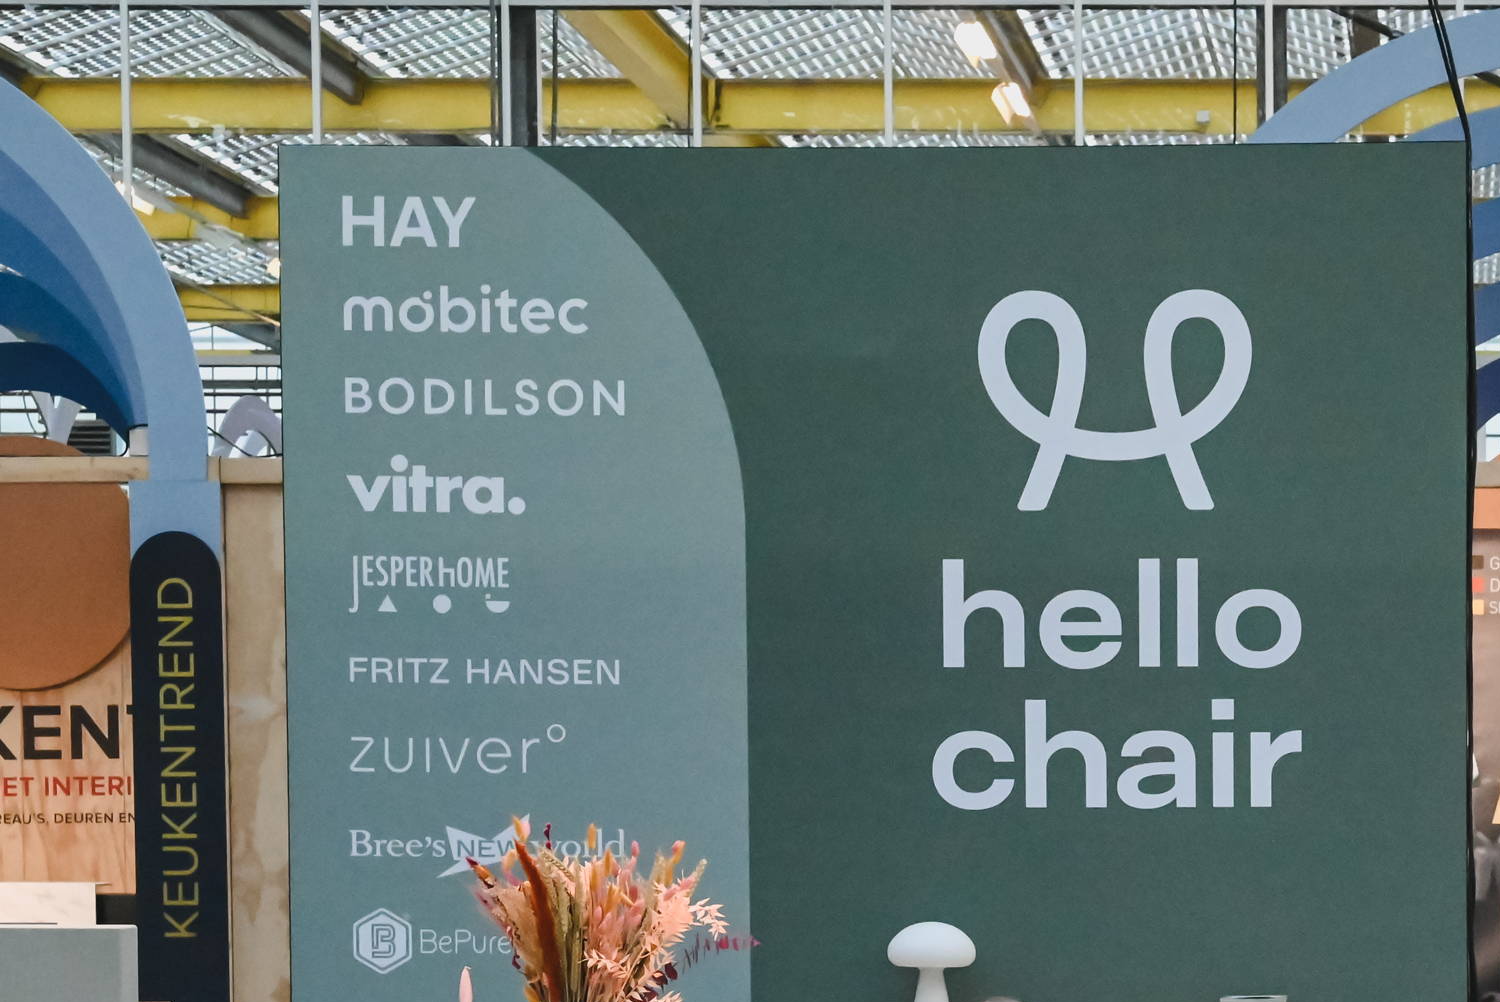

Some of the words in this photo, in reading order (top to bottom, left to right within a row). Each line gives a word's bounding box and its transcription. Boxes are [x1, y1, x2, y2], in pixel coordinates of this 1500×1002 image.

[341, 195, 476, 248] HAY
[344, 376, 626, 417] BODILSON
[346, 454, 526, 515] vitra.
[942, 558, 1302, 670] hello
[348, 657, 450, 684] FRITZ
[466, 658, 621, 685] HANSEN
[156, 576, 200, 939] KEUKENTREND
[932, 698, 1302, 811] chair
[54, 812, 114, 824] DEUREN
[349, 828, 447, 858] Bree's
[420, 929, 512, 954] BePure
